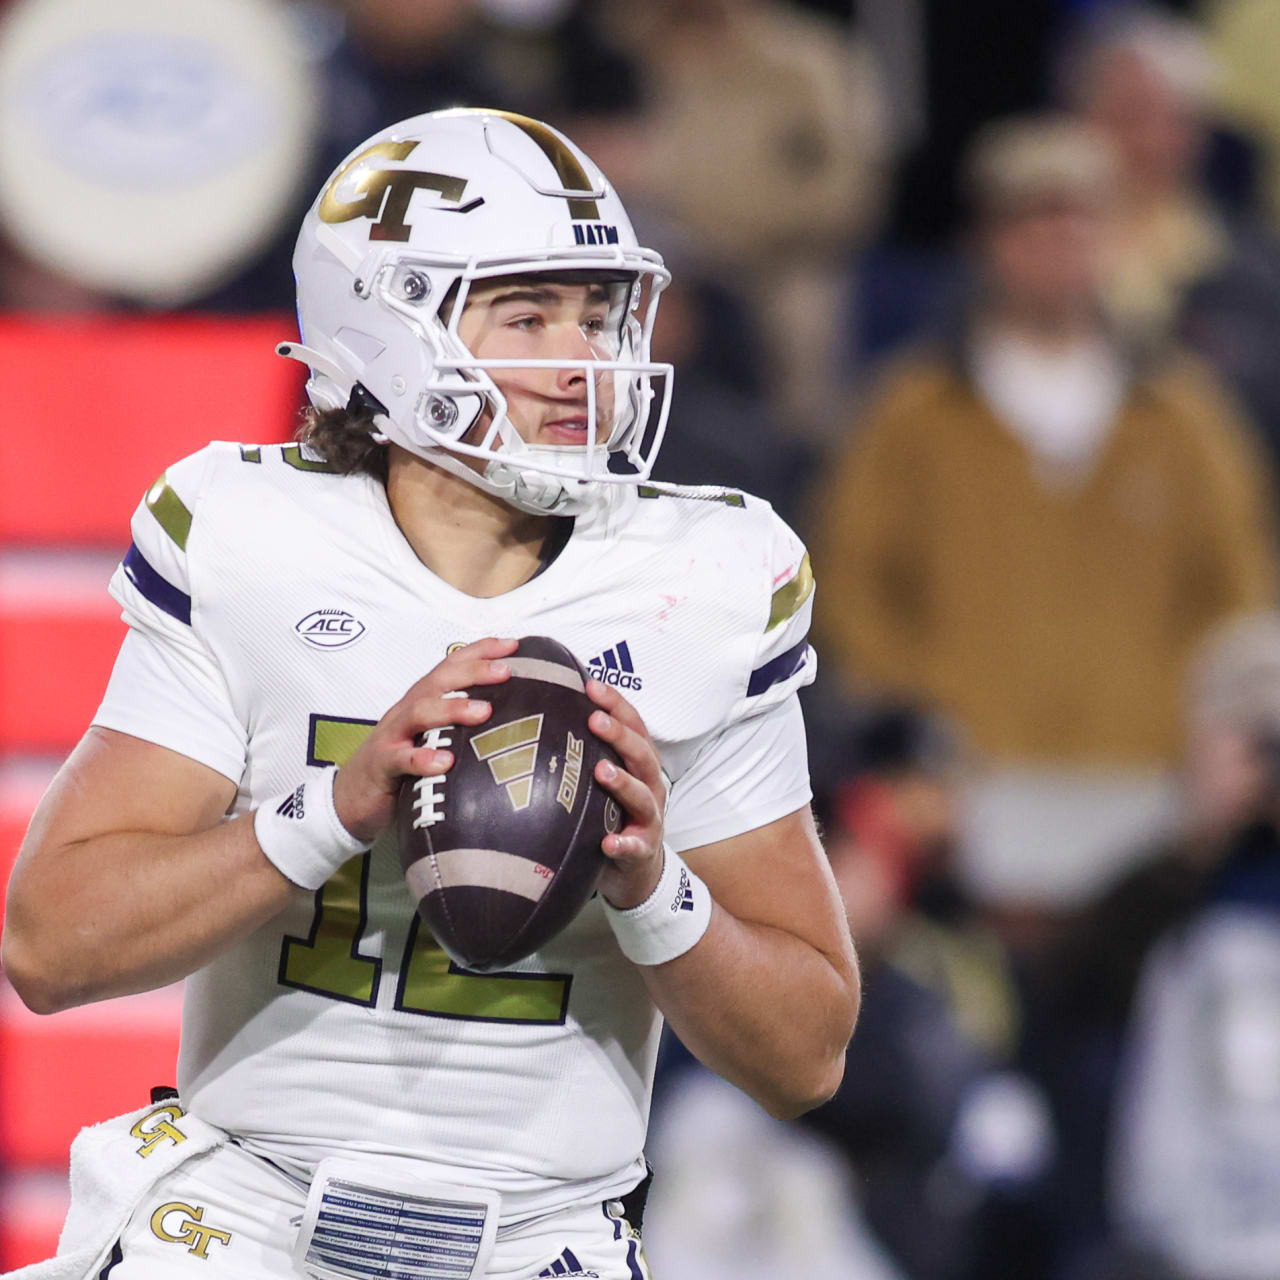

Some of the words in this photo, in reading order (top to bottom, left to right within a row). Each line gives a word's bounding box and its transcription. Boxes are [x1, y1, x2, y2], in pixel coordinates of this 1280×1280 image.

[306, 618, 355, 632] ACC
[586, 666, 643, 691] didas
[557, 731, 584, 814] DIME
[671, 867, 687, 912] adidas
[130, 1105, 187, 1158] GT
[150, 1201, 232, 1259] GT
